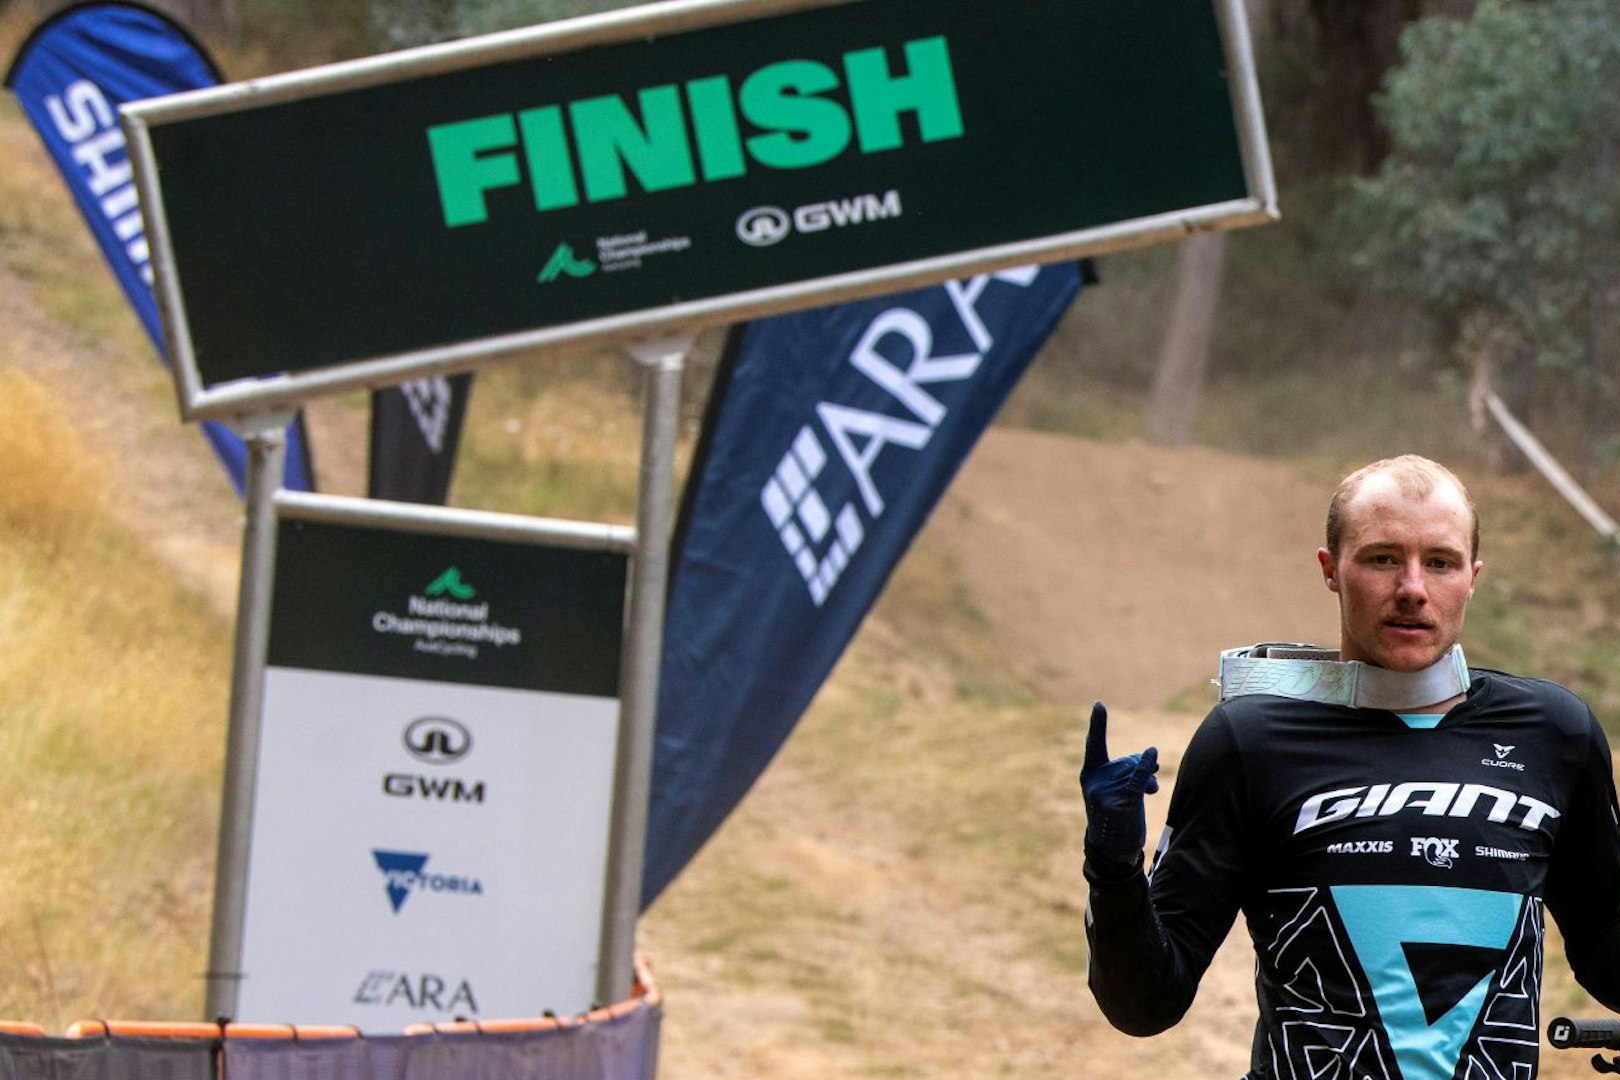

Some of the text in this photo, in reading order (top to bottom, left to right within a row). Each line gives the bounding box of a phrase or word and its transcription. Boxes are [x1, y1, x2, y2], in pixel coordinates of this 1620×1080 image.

[426, 35, 965, 227] FINISH
[794, 190, 901, 234] GWM
[408, 595, 489, 622] National
[372, 611, 521, 647] Championships
[1481, 758, 1526, 772] CUORE
[382, 772, 486, 804] GWM
[1292, 781, 1562, 836] GIANT
[1326, 840, 1394, 854] MAXXIS
[1409, 836, 1460, 869] FOX
